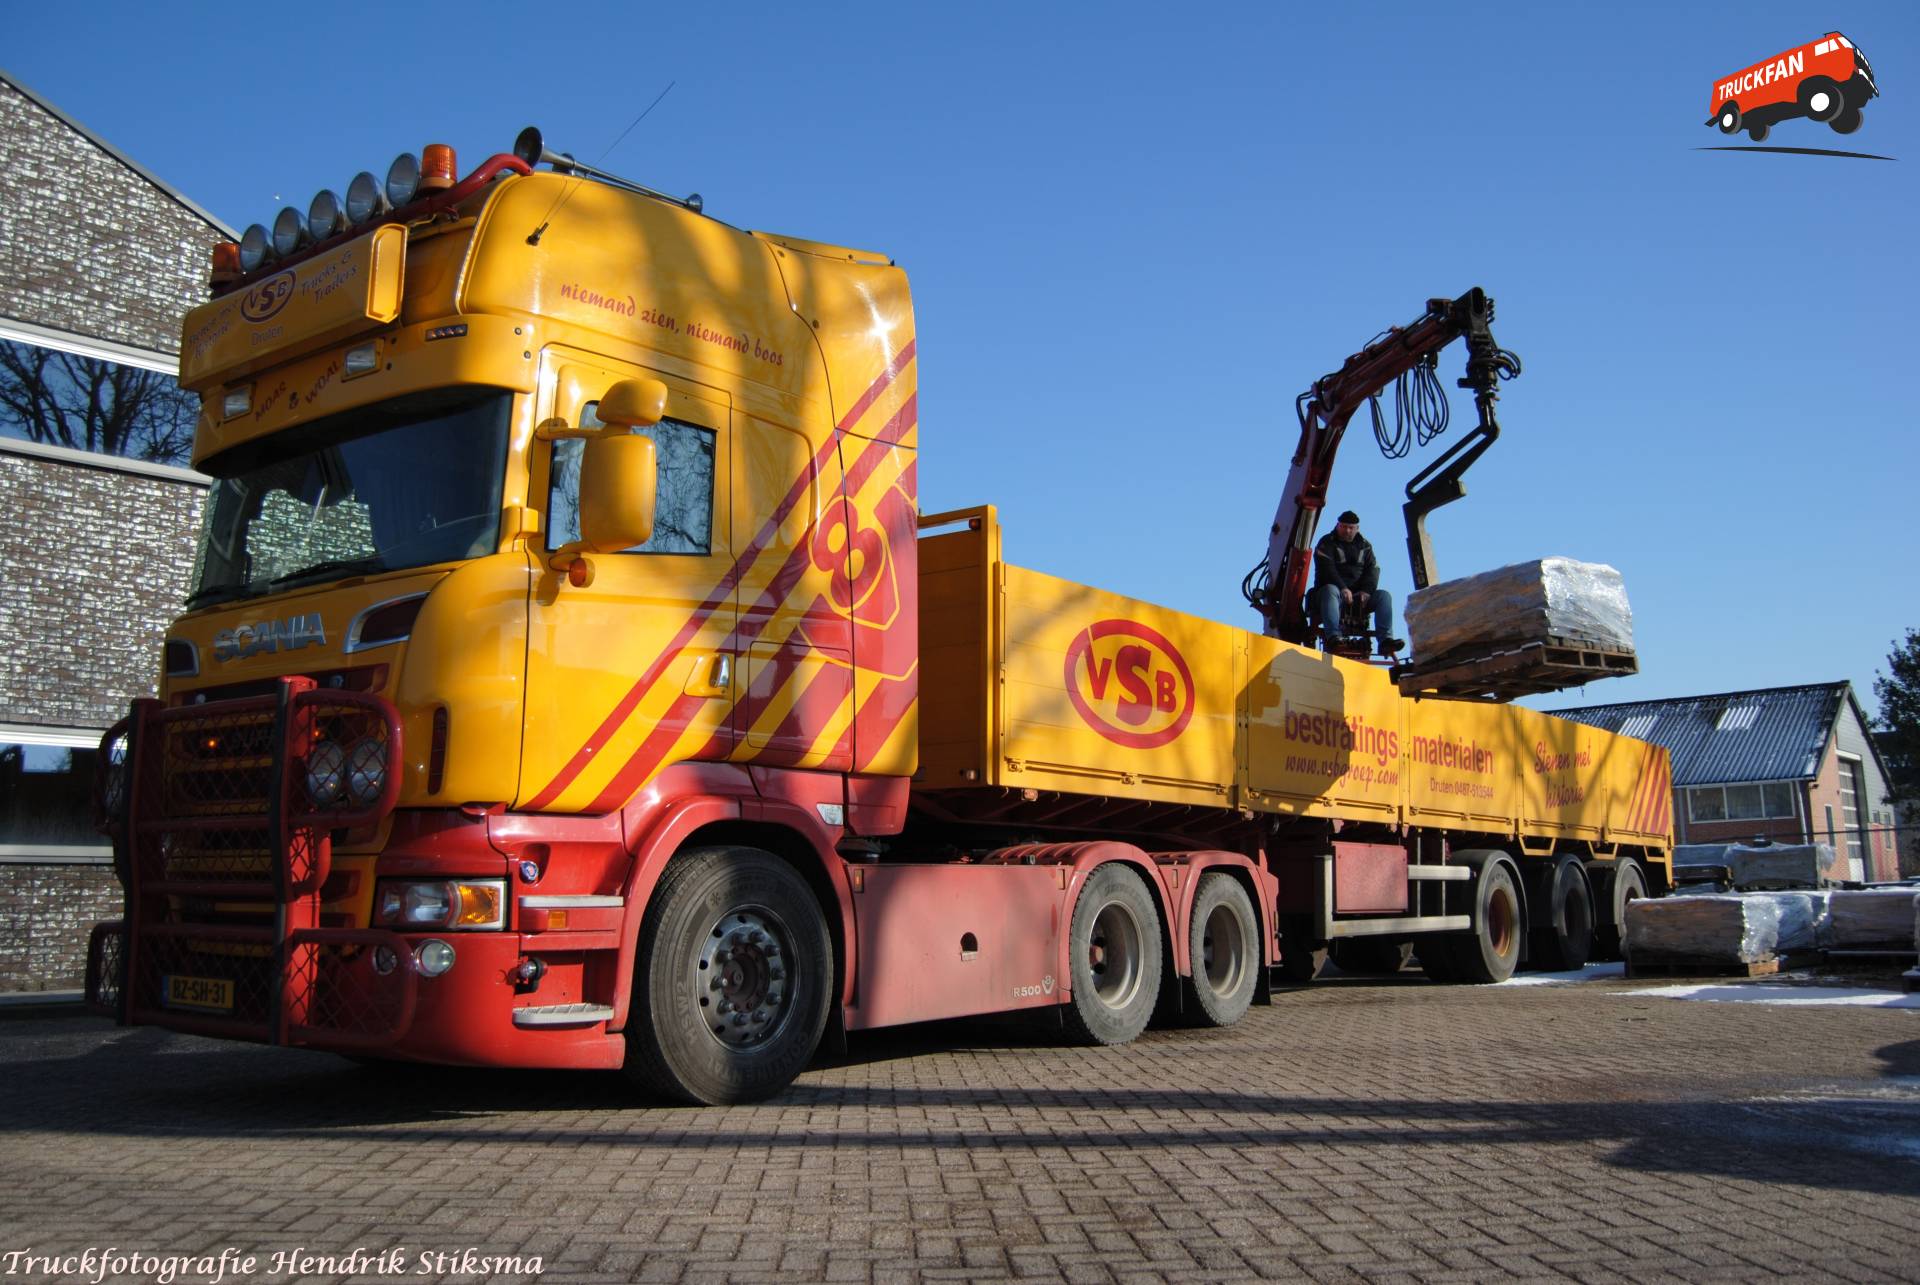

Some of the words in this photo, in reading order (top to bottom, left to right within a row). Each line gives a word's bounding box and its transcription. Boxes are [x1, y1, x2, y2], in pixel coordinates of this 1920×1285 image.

[248, 278, 288, 312] VSB
[560, 283, 636, 317] niemand
[641, 308, 680, 334] zien,
[686, 320, 750, 355] niemand
[754, 338, 784, 367] boos
[213, 612, 327, 663] SCANIA
[1084, 642, 1177, 727] VSB
[1284, 698, 1399, 767] bestratings
[1413, 733, 1494, 774] materialen
[1535, 740, 1570, 774] Stenen
[1574, 735, 1592, 769] met
[1284, 752, 1399, 793] www.vsbgroep.com
[1430, 776, 1453, 794] Druten
[1545, 775, 1584, 809] historie
[1013, 984, 1041, 998] R500
